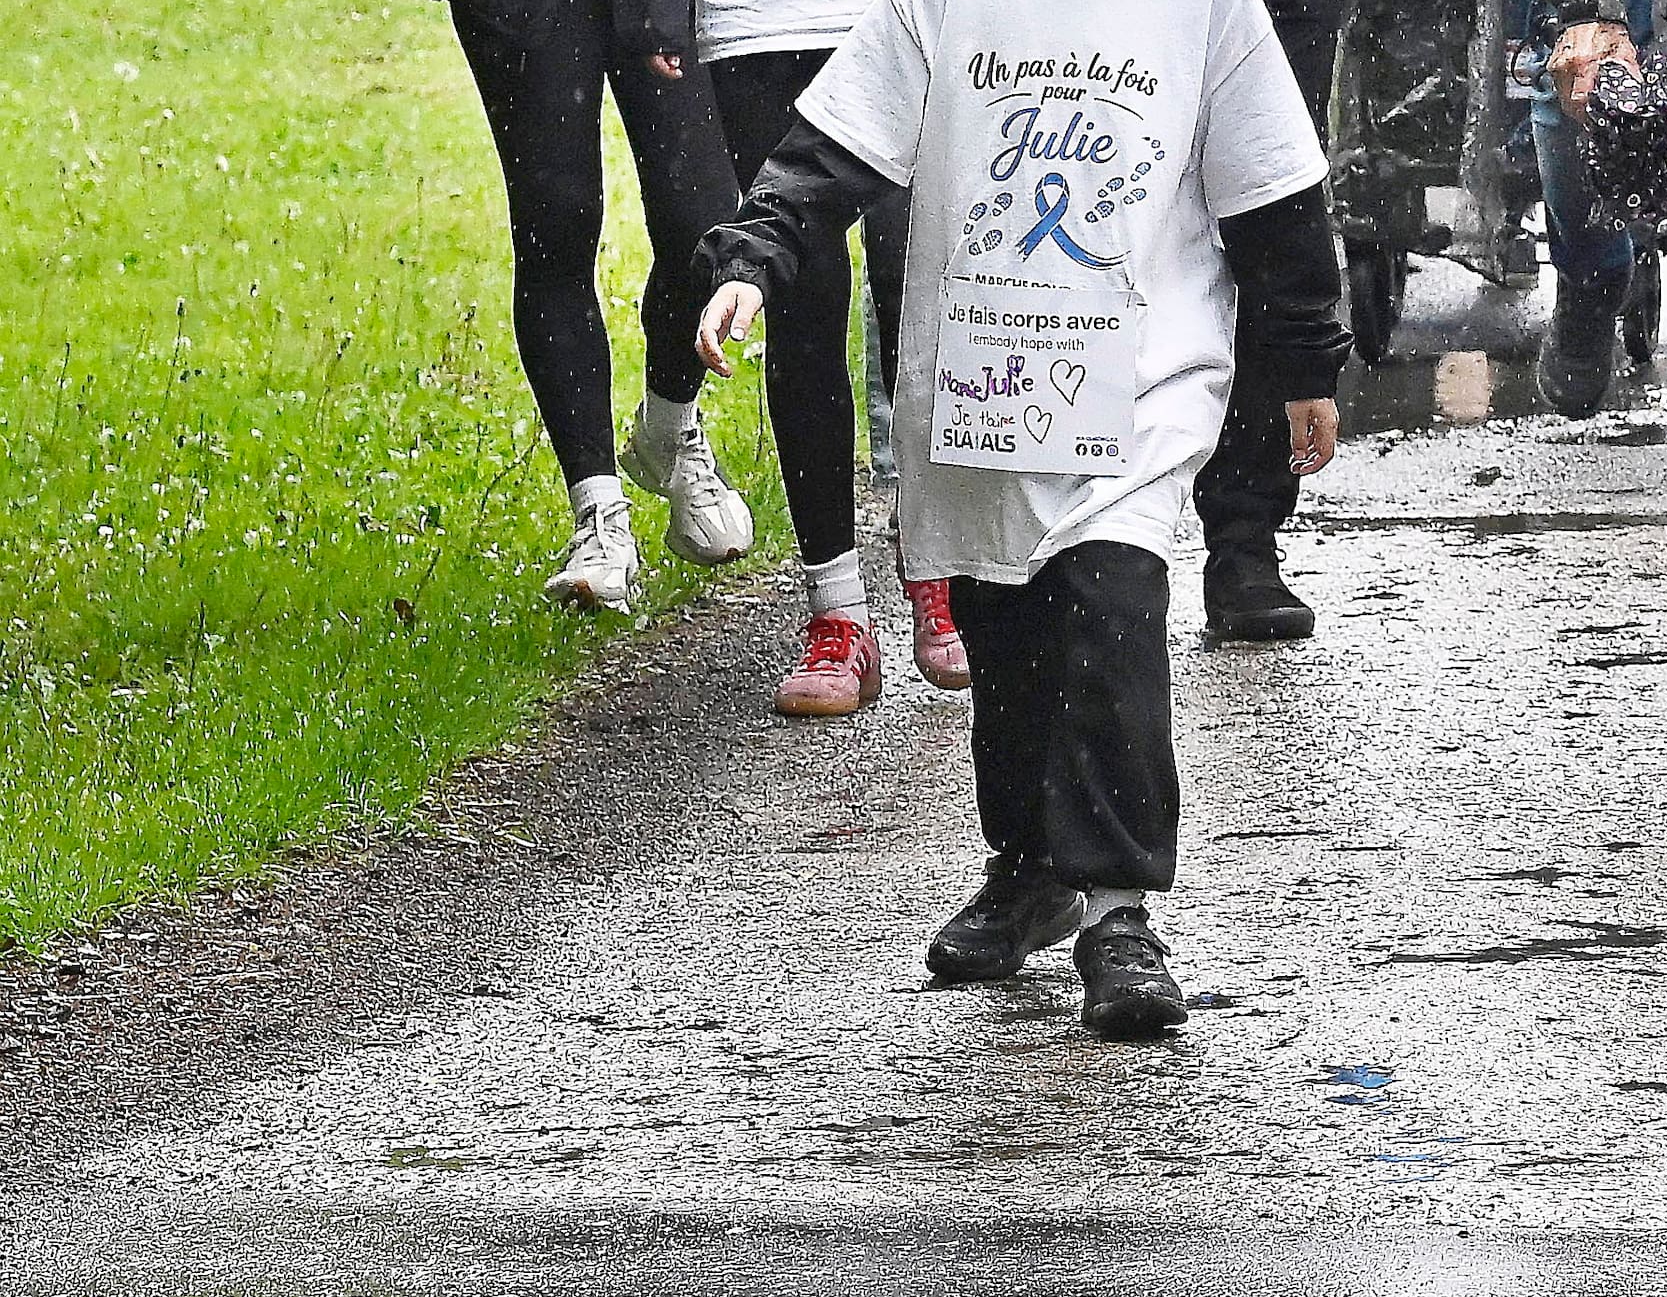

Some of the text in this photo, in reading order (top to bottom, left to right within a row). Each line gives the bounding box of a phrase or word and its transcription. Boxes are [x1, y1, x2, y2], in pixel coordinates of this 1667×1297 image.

[968, 51, 1158, 96] Un pas à la fois
[1041, 85, 1087, 106] pour
[990, 107, 1118, 182] Julie
[948, 302, 1121, 333] Je fais corps avec
[972, 333, 1018, 350] embody
[1020, 336, 1054, 352] hope
[1056, 338, 1085, 352] with
[951, 404, 972, 426] Je
[943, 428, 1016, 453] SLA ALS
